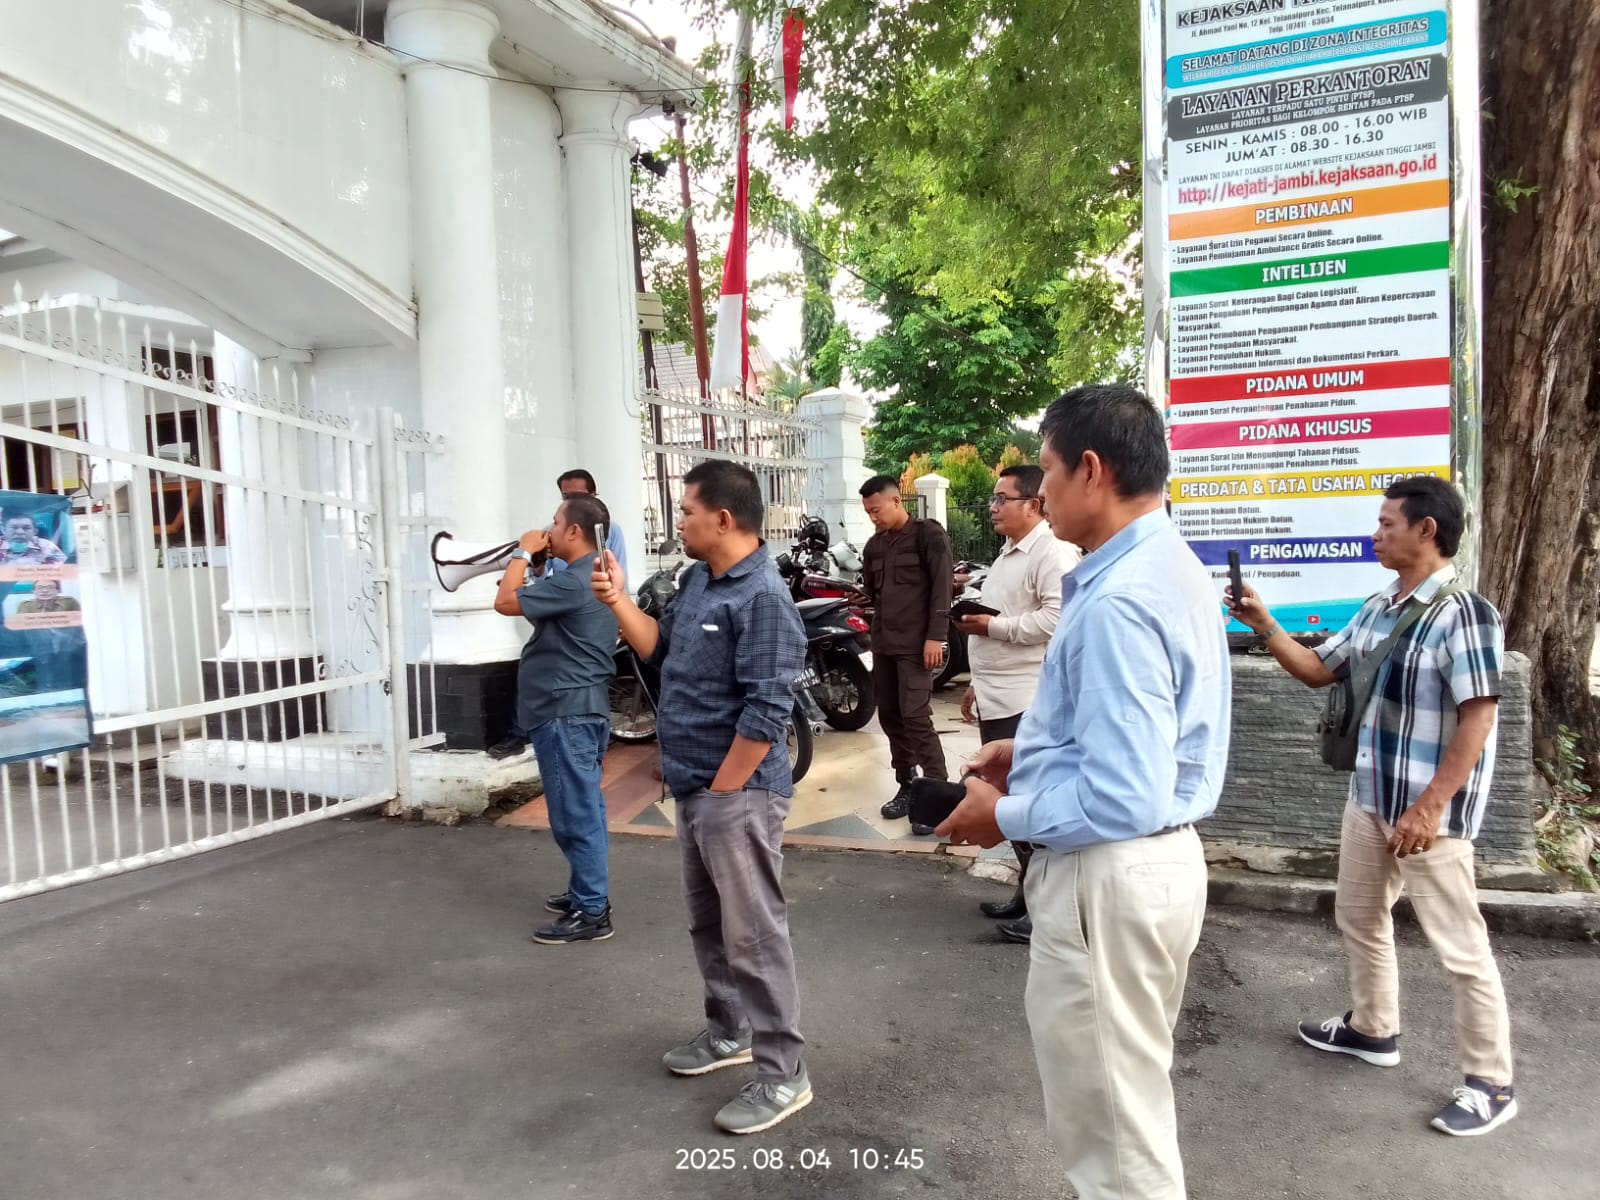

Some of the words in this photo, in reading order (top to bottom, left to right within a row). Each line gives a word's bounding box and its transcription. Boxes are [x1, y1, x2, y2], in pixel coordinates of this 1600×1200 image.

[1177, 0, 1285, 28] KEJAKSAAN
[1199, 24, 1222, 36] Ahmad
[1223, 22, 1237, 32] Yani
[1251, 18, 1258, 27] 12
[1182, 52, 1236, 71] SELAMAT
[1239, 41, 1289, 62] DATANG
[1292, 38, 1307, 53] DI
[1309, 31, 1346, 50] ZONA
[1348, 18, 1429, 43] INTEGRITAS
[1182, 84, 1271, 118] LAYANAN
[1276, 58, 1431, 103] PERKANTORAN
[1196, 122, 1229, 134] LAYANAN
[1231, 116, 1271, 129] PRIORITAS
[1272, 112, 1290, 124] BAGI
[1292, 104, 1336, 119] KELOMPOK
[1338, 100, 1369, 112] RENTAN
[1371, 96, 1392, 107] PADA
[1394, 94, 1414, 103] PTSP
[1232, 107, 1265, 120] LAYANAN
[1267, 101, 1301, 114] TERPADU
[1304, 96, 1324, 108] SATU
[1326, 92, 1349, 104] PINTU
[1351, 90, 1375, 102] (PTSP)
[1186, 138, 1228, 154] SENIN
[1242, 128, 1287, 146] KAMIS
[1300, 120, 1339, 137] 08.00
[1356, 112, 1394, 129] 16.00
[1399, 108, 1428, 122] WIB
[1225, 145, 1277, 163] JUM'AT
[1290, 137, 1329, 154] 08.30
[1345, 130, 1384, 146] 16.30
[1178, 174, 1208, 184] LAYANAN
[1210, 172, 1220, 180] INI
[1222, 168, 1243, 179] DAPAT
[1244, 164, 1273, 176] DIAKSES
[1274, 164, 1282, 172] DI
[1284, 160, 1312, 170] ALAMAT
[1312, 154, 1342, 166] WEBSITE
[1344, 148, 1384, 161] KEJAKSAAN
[1386, 144, 1412, 156] TINGGI
[1414, 142, 1436, 153] JAMBI
[1178, 153, 1438, 204] http://kejati-jambi.kejaksaan.go.id
[1255, 198, 1353, 224] PEMBINAAN
[1177, 243, 1208, 254] Layanan
[1208, 240, 1228, 250] Surat
[1230, 239, 1243, 248] Izin
[1244, 234, 1277, 246] Pegawai
[1278, 232, 1306, 242] Secara
[1177, 254, 1208, 264] Layanan
[1209, 249, 1255, 261] Peminjaman
[1257, 243, 1300, 255] Ambulance
[1302, 238, 1325, 250] Gratis
[1326, 236, 1354, 247] Secara
[1262, 258, 1346, 282] INTELIJEN
[1178, 303, 1208, 312] Layanan
[1209, 300, 1229, 308] Surat
[1232, 296, 1276, 306] Keterangan
[1277, 292, 1294, 302] Bagi
[1296, 290, 1318, 299] Calon
[1178, 314, 1208, 322] Layanan
[1209, 309, 1250, 320] Pengaduan
[1252, 302, 1309, 315] Penyimpangan
[1310, 298, 1338, 310] Agama
[1339, 297, 1354, 306] dan
[1356, 294, 1380, 304] Aliran
[1382, 290, 1436, 302] Kepercayaan
[1178, 322, 1222, 332] Masyarakat.
[1178, 334, 1208, 342] Layanan
[1210, 329, 1256, 340] Permohonan
[1258, 324, 1308, 336] Pengamanan
[1310, 318, 1366, 330] Pembangunan
[1368, 314, 1405, 326] Strategis
[1178, 345, 1208, 354] Layanan
[1210, 340, 1250, 350] Pengaduan
[1252, 336, 1299, 346] Masyarakat.
[1178, 355, 1208, 364] Layanan
[1210, 350, 1253, 361] Penyuluhan
[1178, 366, 1208, 374] Layanan
[1210, 360, 1256, 372] Permohonan
[1258, 357, 1295, 368] Informasi
[1296, 355, 1311, 364] dan
[1313, 351, 1365, 362] Dokumentasi
[1366, 349, 1400, 358] Perkara.
[1246, 374, 1308, 394] PIDANA
[1312, 370, 1364, 388] UMUM
[1178, 408, 1208, 418] Layanan
[1210, 406, 1230, 415] Surat
[1232, 403, 1284, 414] Perpanjangan
[1286, 400, 1328, 410] Penahanan
[1240, 422, 1300, 440] PIDANA
[1305, 418, 1372, 436] KHUSUS
[1179, 455, 1208, 464] Layanan
[1210, 453, 1230, 461] Surat
[1232, 452, 1244, 460] Izin
[1246, 448, 1296, 460] Mengunjungi
[1298, 447, 1330, 457] Tahanan
[1332, 446, 1361, 455] Pidsus.
[1179, 465, 1208, 474] Layanan
[1210, 463, 1230, 472] Surat
[1232, 460, 1284, 472] Perpanjangan
[1286, 458, 1329, 468] Penahanan
[1331, 456, 1359, 466] Pidsus.
[1180, 480, 1248, 498] PERDATA
[1252, 479, 1265, 494] &
[1268, 478, 1308, 494] TATA
[1311, 474, 1366, 492] USAHA
[1180, 508, 1209, 516] Layanan
[1180, 518, 1209, 526] Layanan
[1211, 517, 1241, 525] Bantuan
[1243, 516, 1269, 524] Hukum
[1180, 528, 1209, 536] Layanan
[1211, 527, 1264, 536] Pertimbangan
[1250, 542, 1362, 560] PENGAWASAN
[1258, 570, 1302, 579] Pengaduan.
